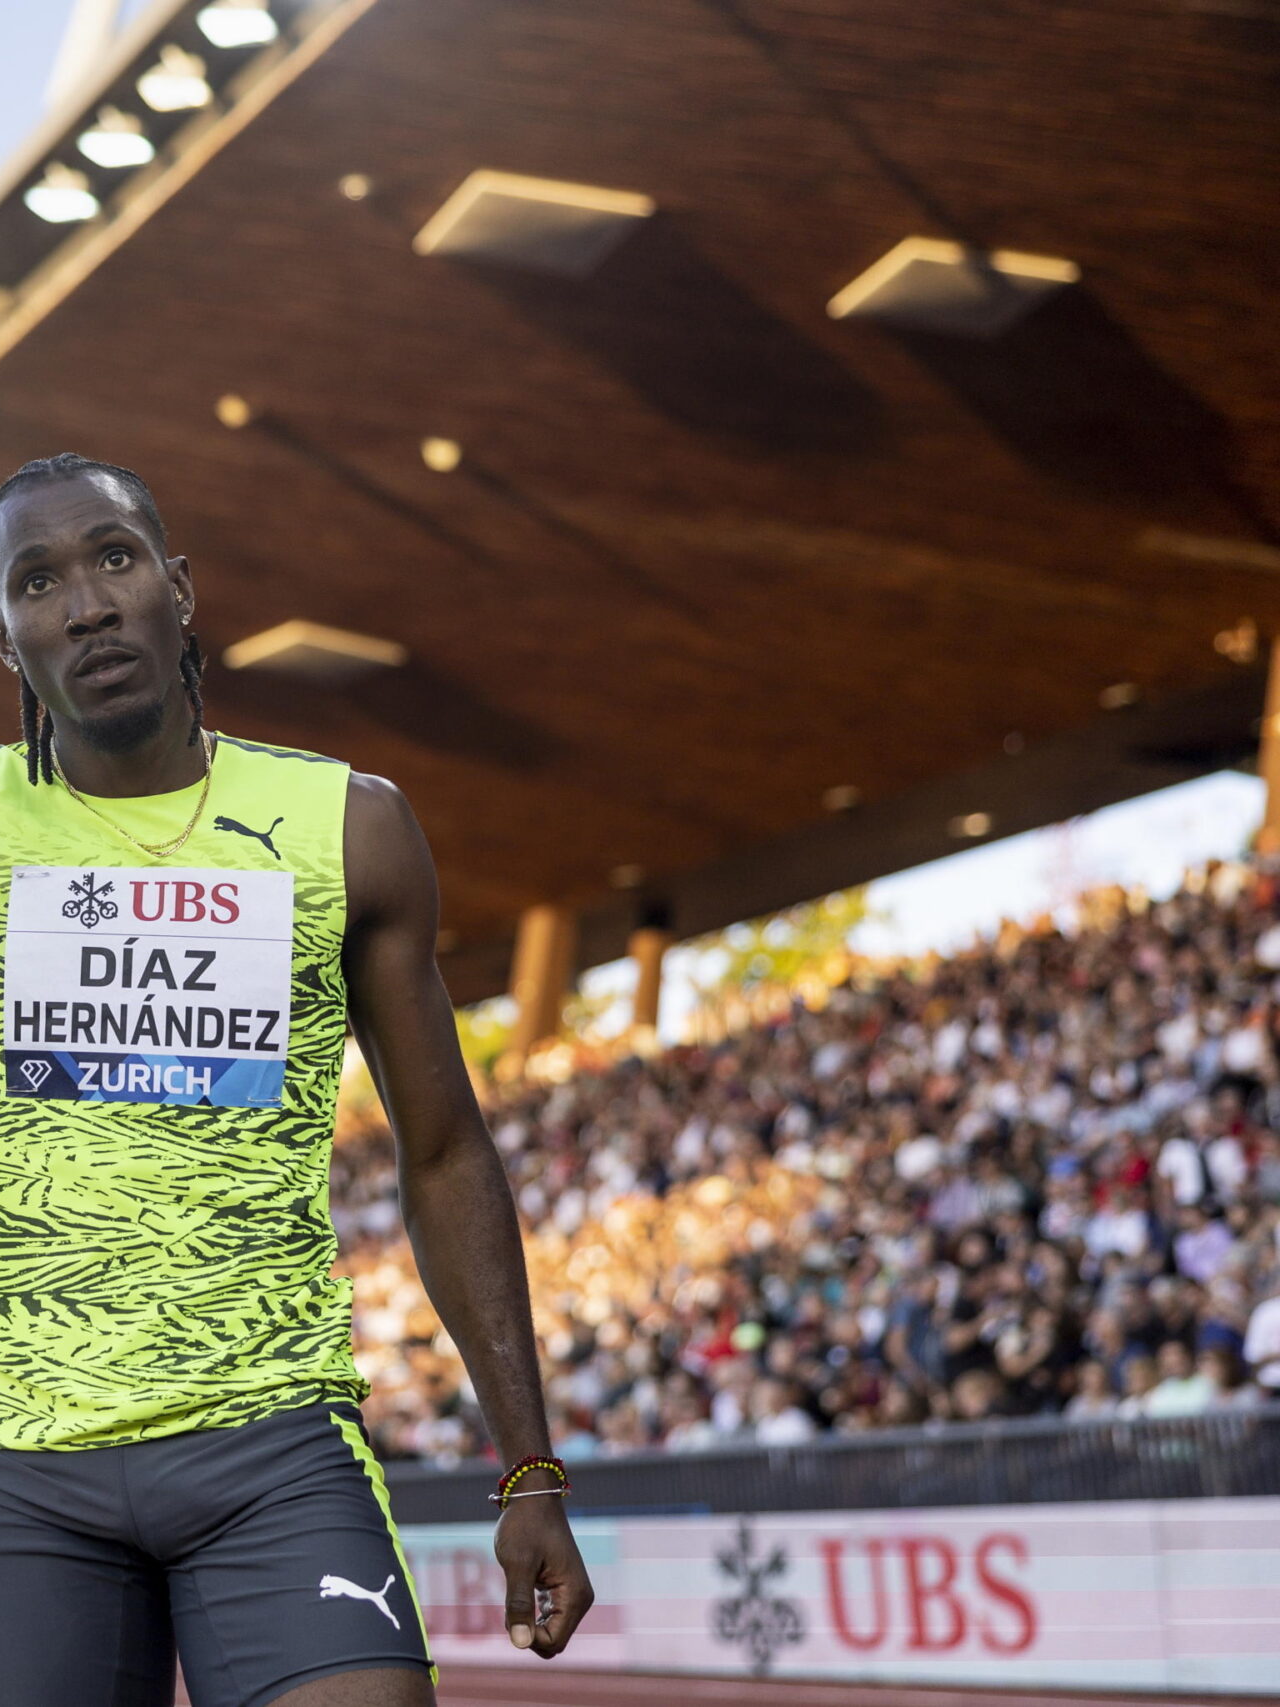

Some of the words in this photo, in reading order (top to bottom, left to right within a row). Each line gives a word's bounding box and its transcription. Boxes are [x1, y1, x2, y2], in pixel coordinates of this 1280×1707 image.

[129, 881, 240, 924] UBS
[80, 937, 217, 992] DÍAZ
[13, 993, 281, 1052] HERNÁNDEZ
[77, 1061, 212, 1096] ZURICH
[404, 1544, 508, 1640] UB
[813, 1531, 1038, 1656] UBS
